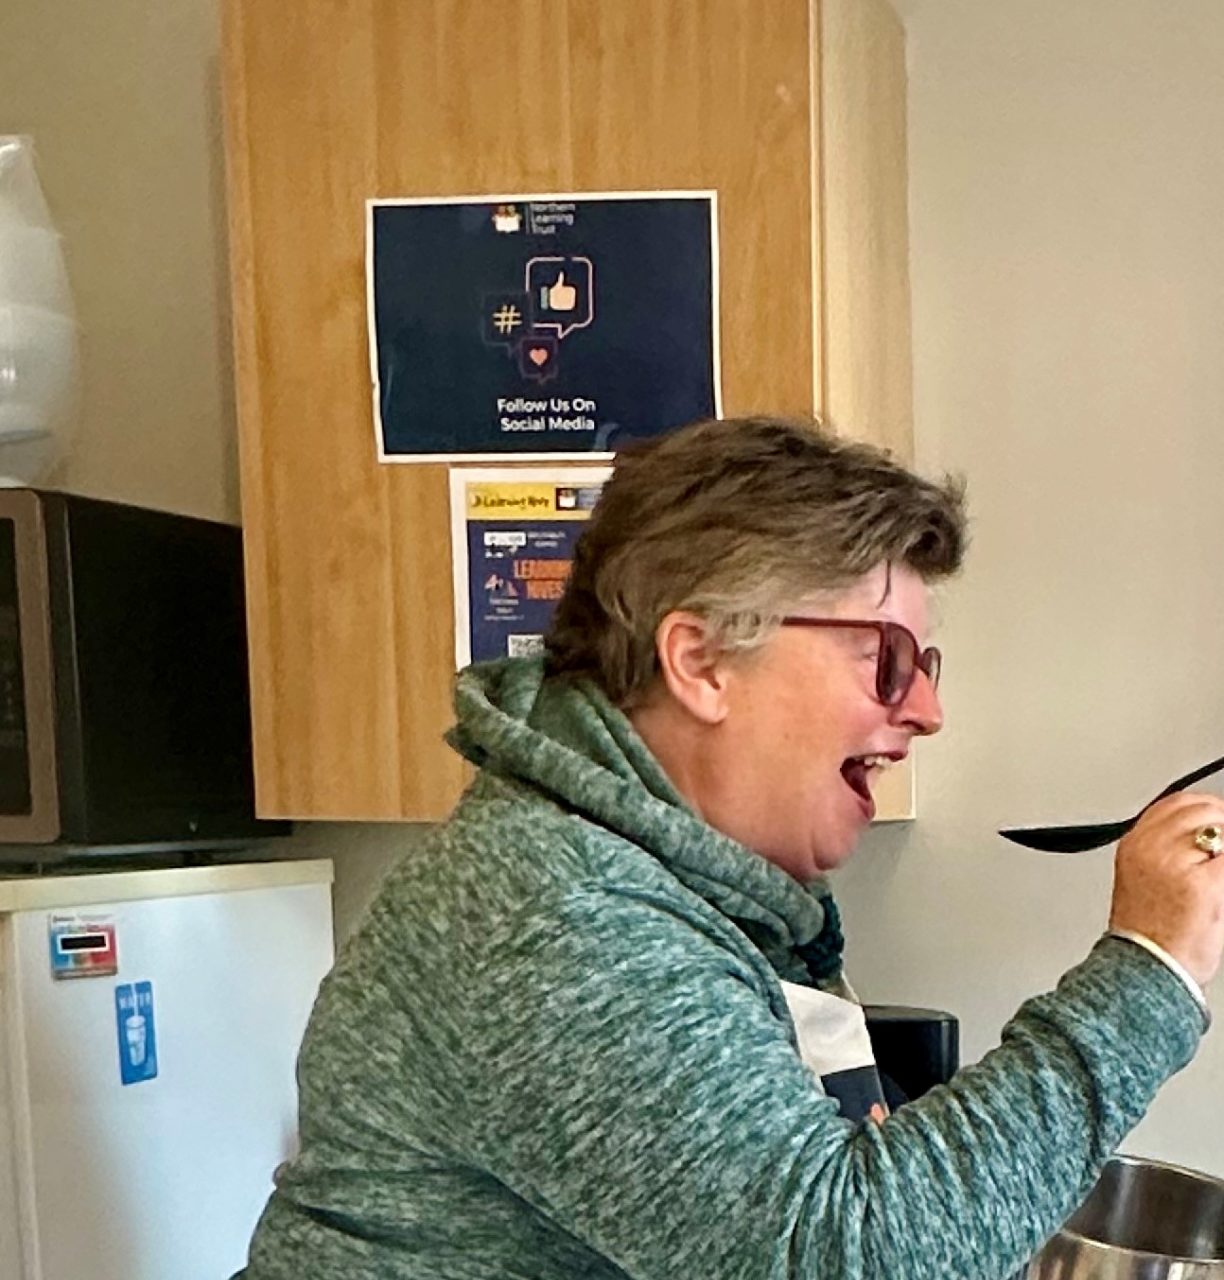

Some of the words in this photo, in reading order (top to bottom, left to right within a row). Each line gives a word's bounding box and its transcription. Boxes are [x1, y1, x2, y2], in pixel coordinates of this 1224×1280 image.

[497, 397, 548, 413] Follow
[549, 397, 570, 413] Us
[572, 397, 597, 413] On
[500, 416, 546, 431] Social
[548, 416, 595, 431] Media
